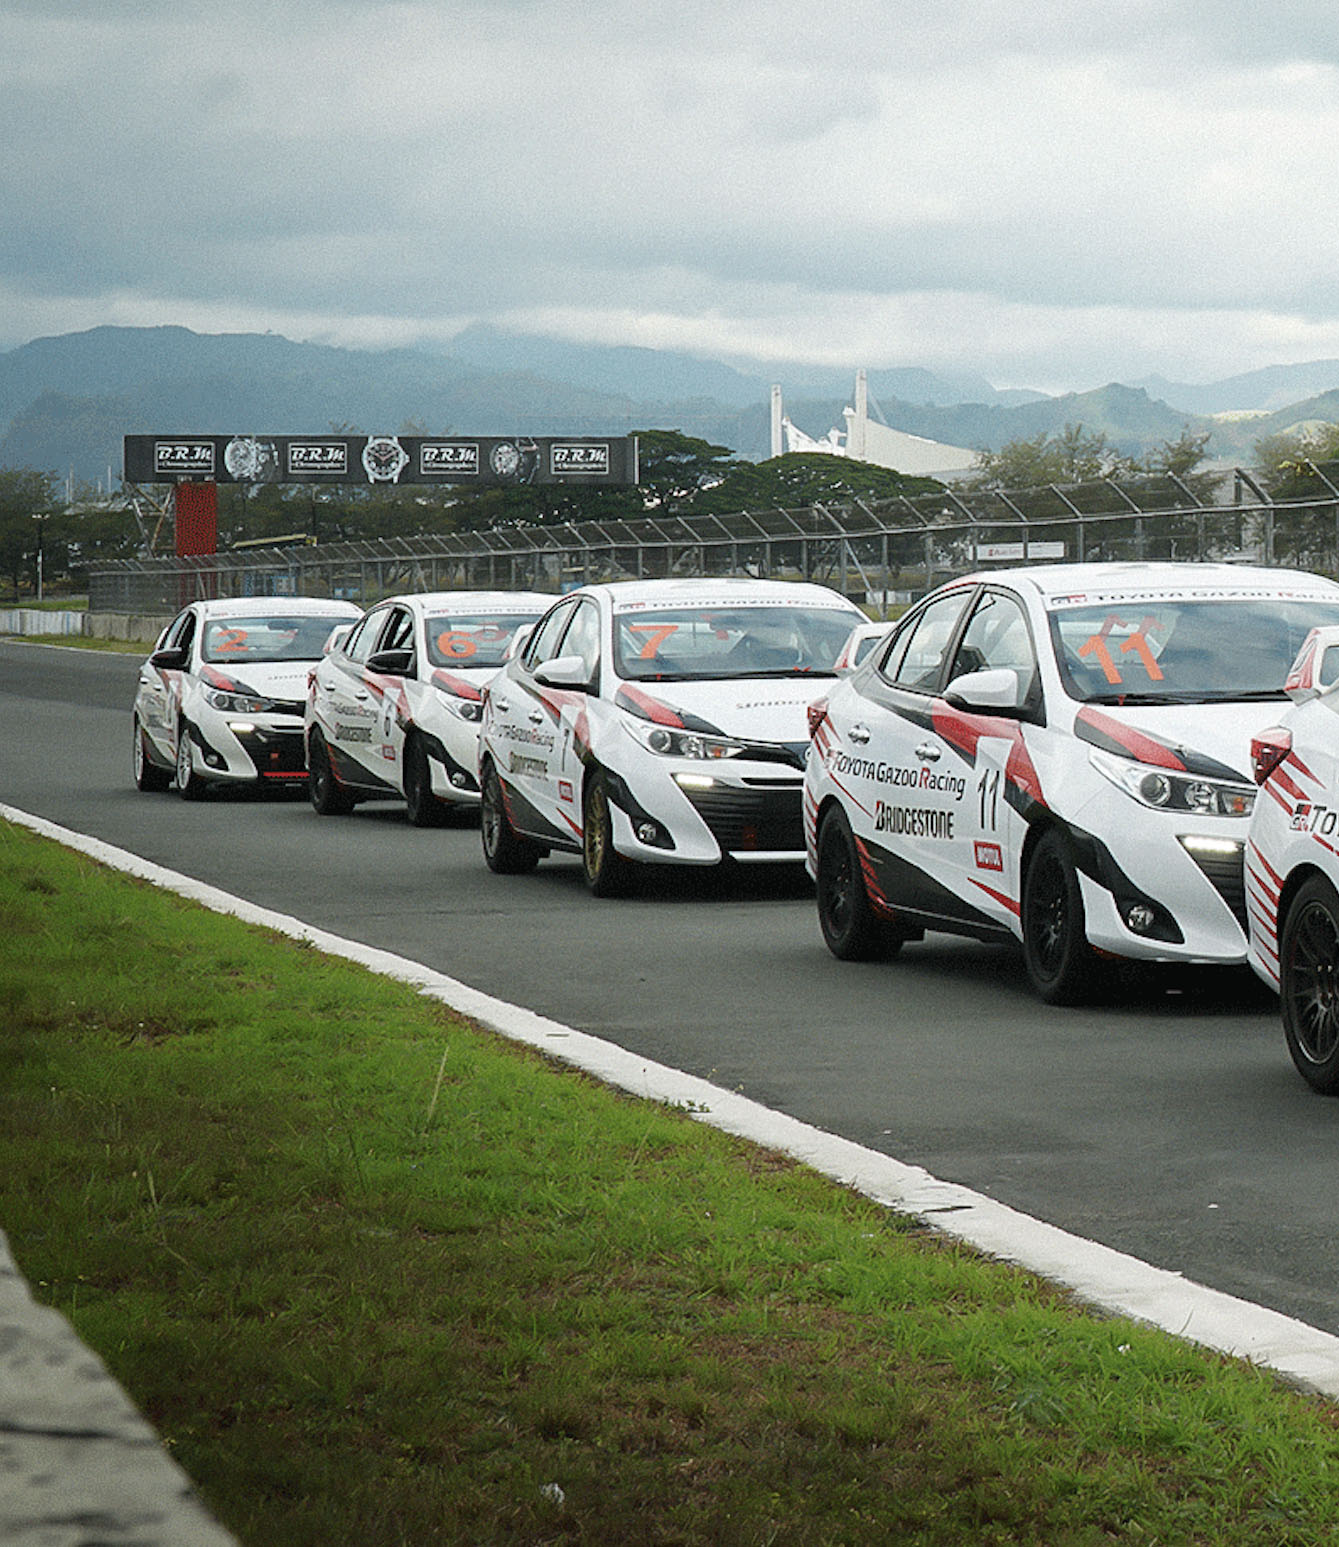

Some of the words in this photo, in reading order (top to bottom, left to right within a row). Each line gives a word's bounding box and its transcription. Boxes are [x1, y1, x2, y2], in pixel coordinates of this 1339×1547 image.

[216, 629, 248, 652] 2
[438, 631, 477, 658] 6
[629, 625, 678, 659] 7
[1078, 632, 1165, 684] 11
[833, 751, 875, 779] TOYOTA
[877, 763, 917, 787] GAZOO
[918, 768, 966, 801] Racing
[875, 800, 954, 839] BRIDGESTONE
[978, 769, 1000, 831] 11
